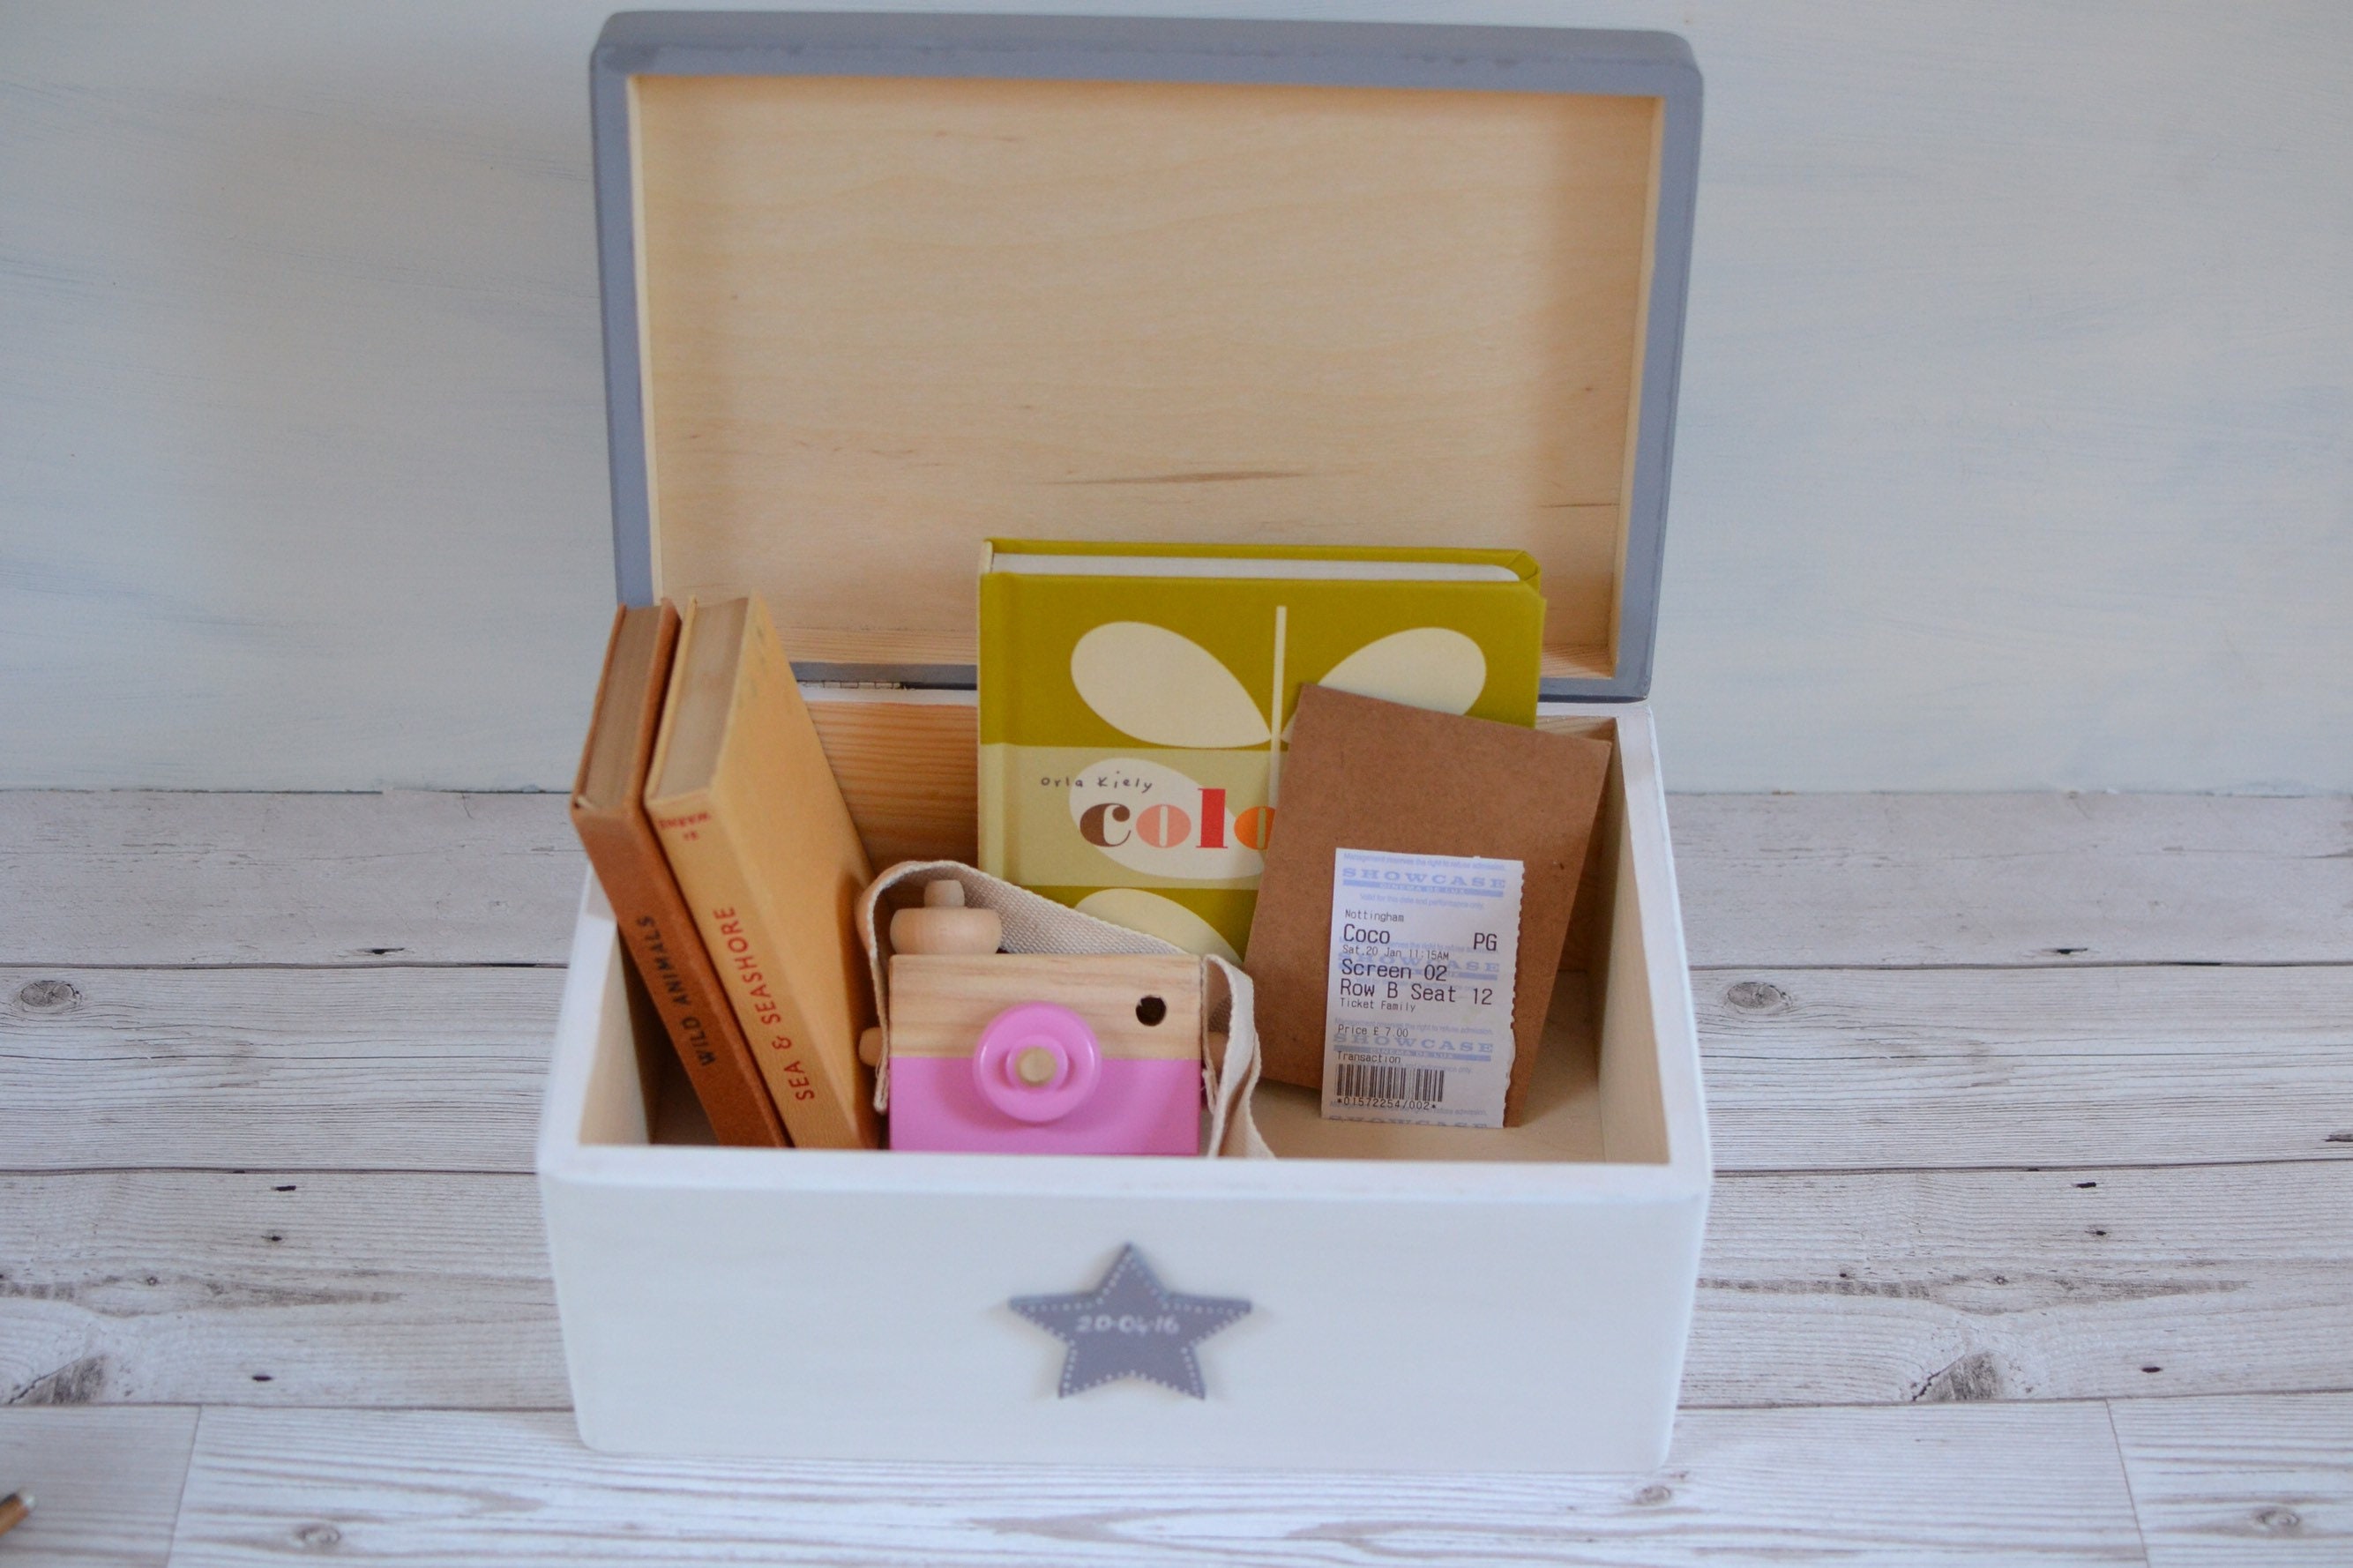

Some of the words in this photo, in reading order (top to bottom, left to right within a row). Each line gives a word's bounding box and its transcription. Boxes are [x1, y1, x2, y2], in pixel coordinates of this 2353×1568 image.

[1041, 776, 1083, 787] Orla
[1097, 771, 1153, 793] Kiely
[1342, 868, 1506, 889] SHOWCASE
[1345, 909, 1404, 922] Nottingham
[1343, 923, 1391, 945] Coco
[1473, 932, 1498, 952] PG
[637, 915, 691, 1006] ANIMALS
[1384, 947, 1401, 958] Jan
[1409, 949, 1449, 960] 11:15AM
[713, 907, 782, 1025] SEASHORE
[1341, 959, 1411, 979] Screen
[1423, 964, 1447, 982] 02
[1340, 978, 1375, 997] Row
[1387, 982, 1399, 998] B
[1411, 983, 1456, 1003] Seat
[1473, 988, 1493, 1005] 12
[1340, 997, 1374, 1010] Ticket
[1380, 1001, 1416, 1012] Family
[681, 1016, 716, 1066] WILD
[1338, 1024, 1368, 1035] Price
[1373, 1027, 1379, 1035] £
[1385, 1027, 1408, 1038] 7.00
[772, 1035, 792, 1049] &
[1333, 1033, 1493, 1054] SHOWCASE
[1337, 1050, 1401, 1064] Transaction
[782, 1060, 815, 1101] SEA
